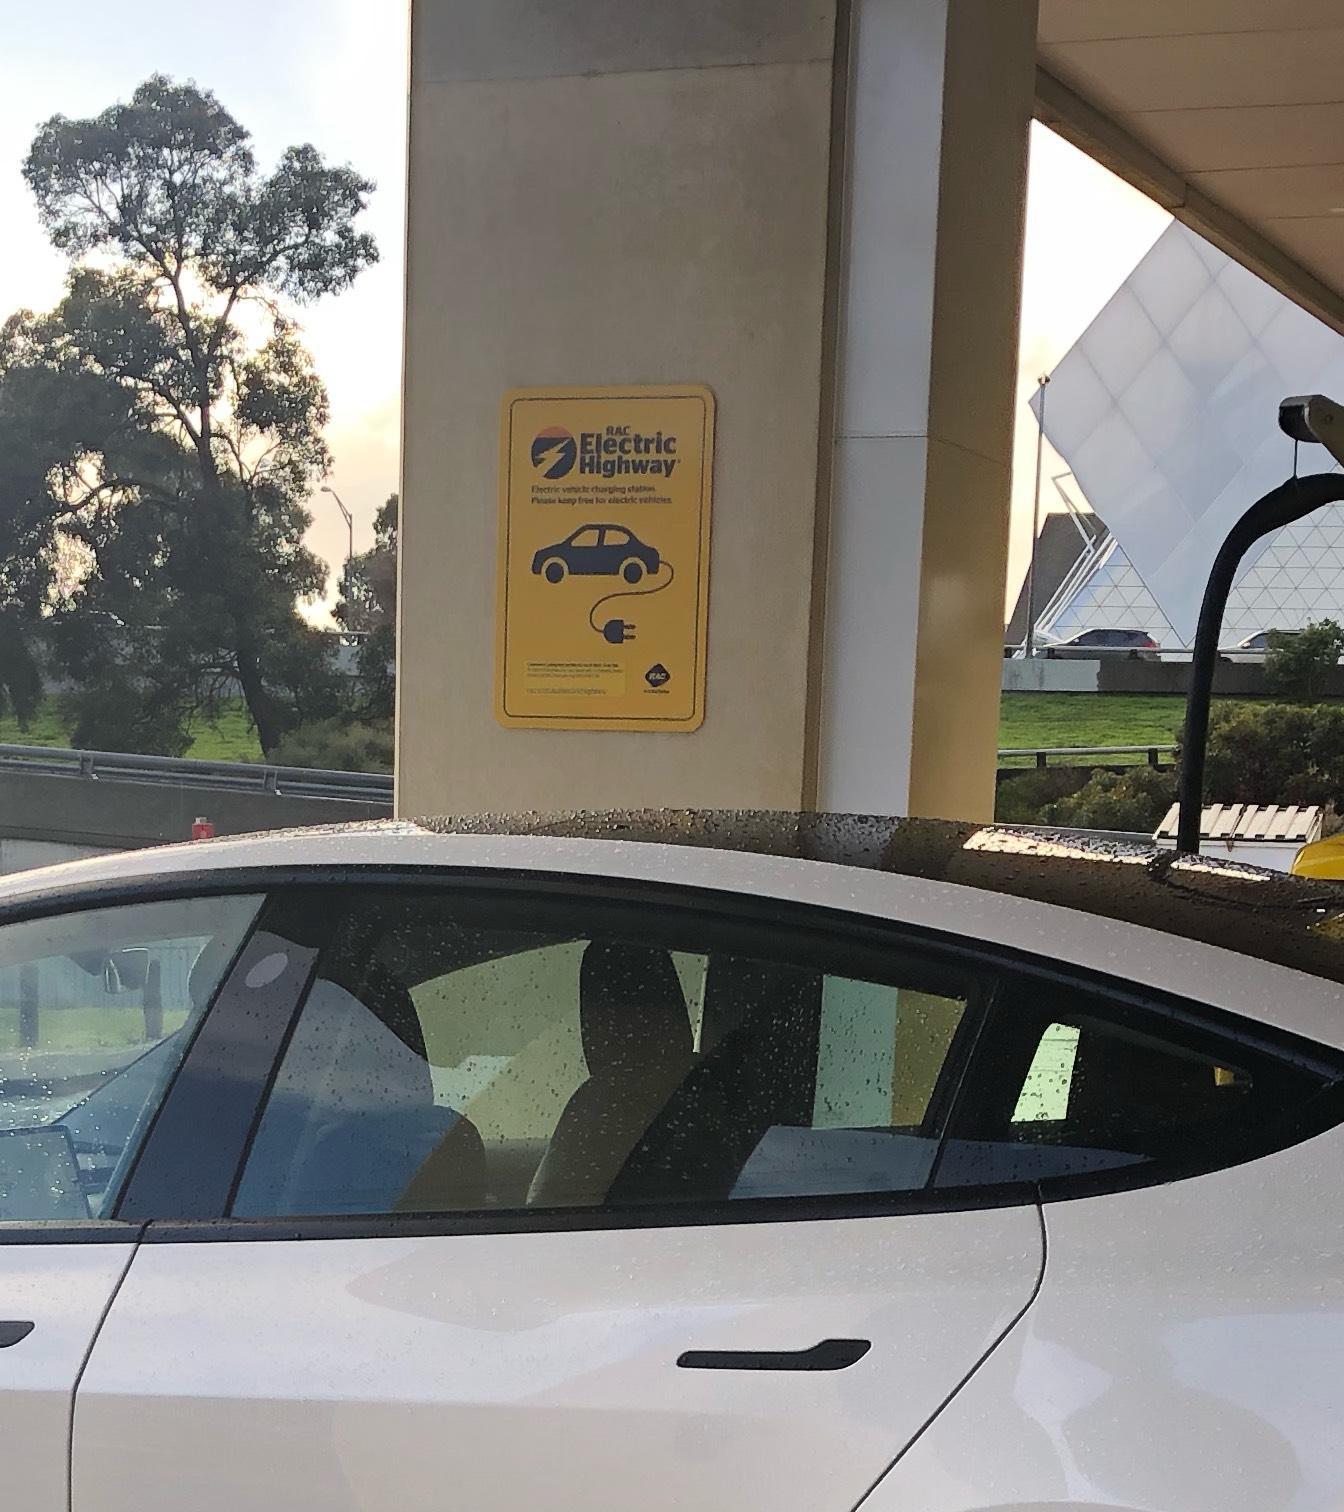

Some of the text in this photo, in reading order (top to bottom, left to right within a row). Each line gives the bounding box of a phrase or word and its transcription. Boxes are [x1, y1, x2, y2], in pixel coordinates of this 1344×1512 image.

[605, 425, 631, 436] RAC
[580, 430, 677, 455] Electric
[579, 455, 677, 478] Highway
